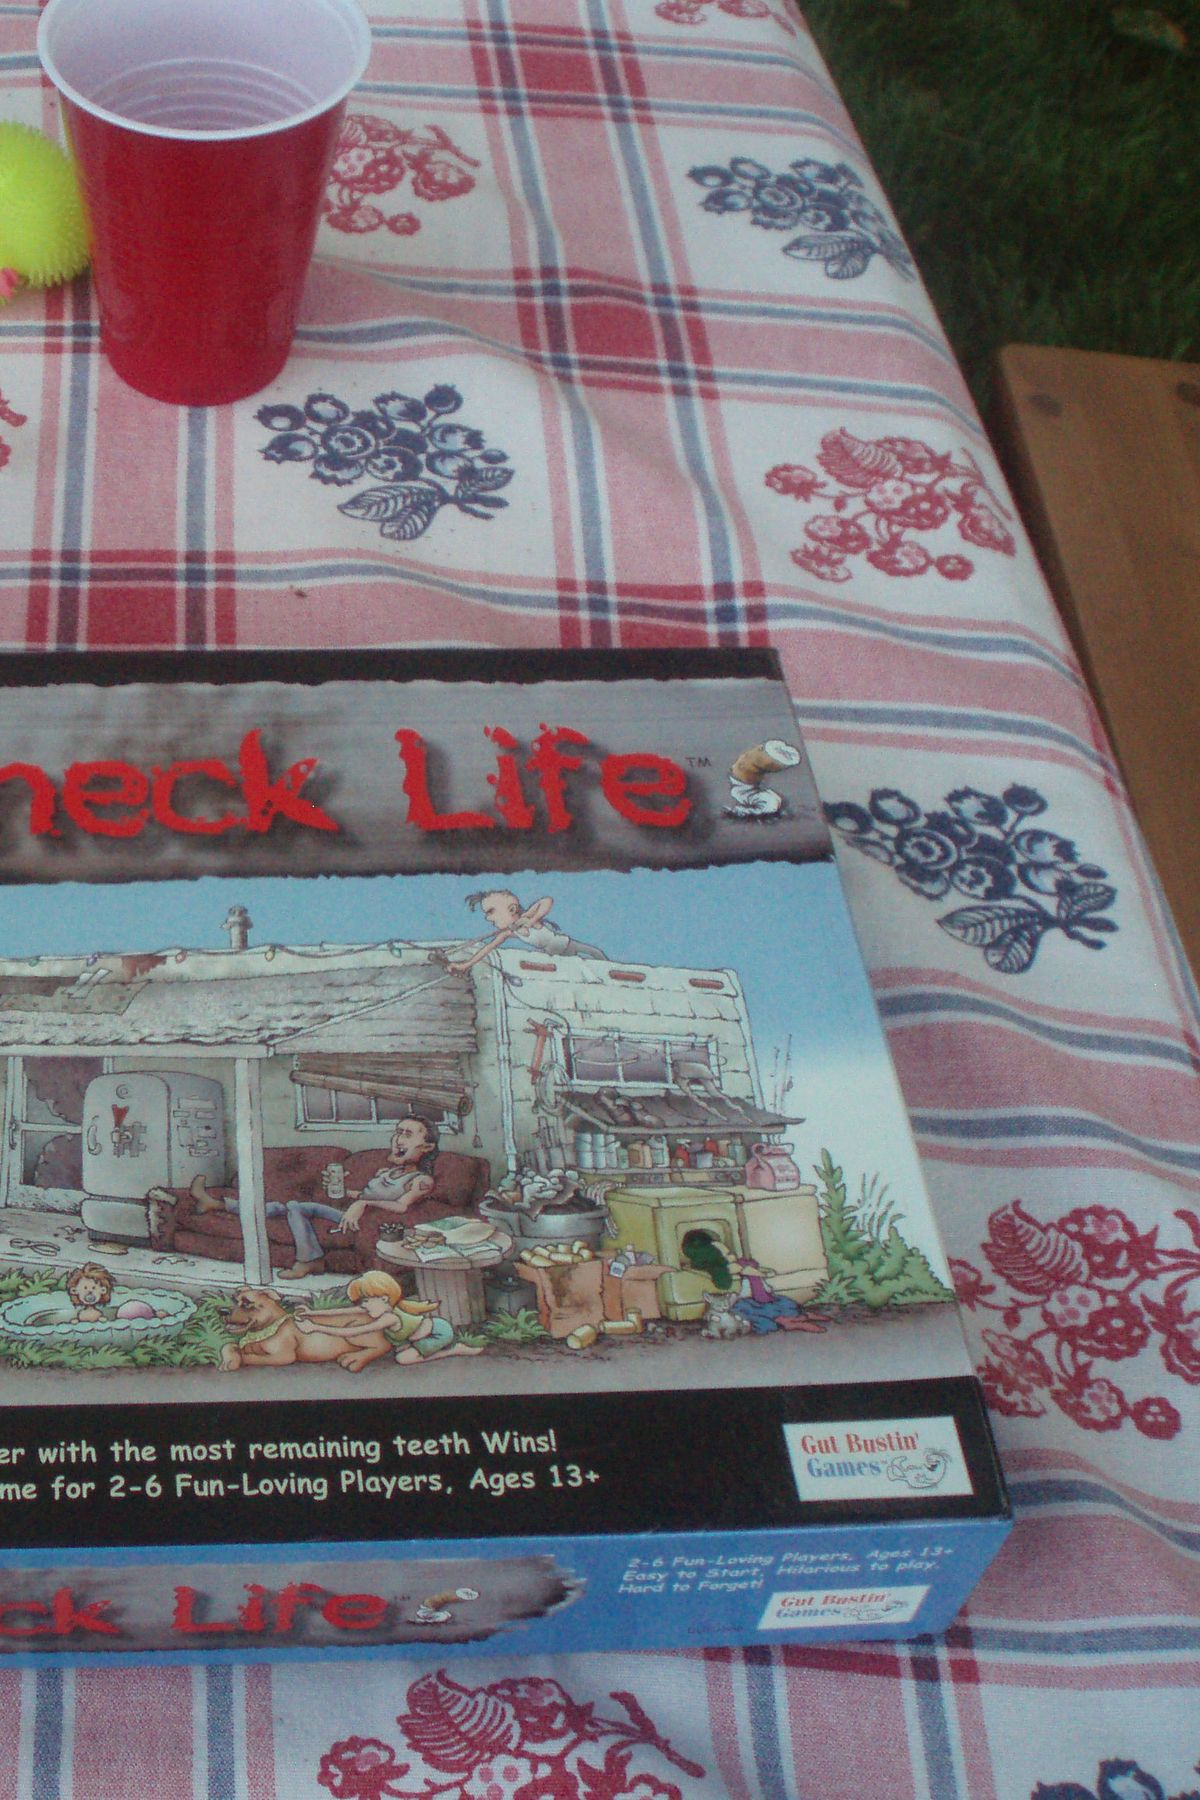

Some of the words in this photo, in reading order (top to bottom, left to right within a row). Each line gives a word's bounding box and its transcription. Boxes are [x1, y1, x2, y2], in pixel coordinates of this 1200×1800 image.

[394, 722, 692, 833] Life
[38, 1439, 97, 1464] with
[110, 1439, 157, 1462] the
[170, 1440, 236, 1462] most
[249, 1436, 381, 1464] remaining
[392, 1432, 471, 1457] teeth
[481, 1429, 558, 1454] Wins!
[801, 1435, 839, 1455] Gut
[845, 1431, 919, 1454] Bustin'
[807, 1458, 881, 1478] Games
[50, 1475, 96, 1500] for
[109, 1474, 162, 1498] 2-6
[175, 1472, 328, 1501] Fun-Loving
[340, 1469, 453, 1499] Players,
[469, 1467, 536, 1496] Ages
[549, 1464, 601, 1488] 13+
[628, 1557, 664, 1569] 2-6
[672, 1554, 775, 1567] Fun-Loving
[866, 1549, 912, 1561] Ages
[920, 1546, 954, 1557] 13+
[622, 1570, 669, 1582] Easy
[677, 1570, 697, 1580] to
[777, 1561, 862, 1575] Hilarious
[870, 1561, 889, 1571] to
[618, 1583, 665, 1594] Hard
[673, 1583, 691, 1592] to
[171, 1582, 388, 1634] Life
[776, 1608, 842, 1619] Games
[780, 1596, 816, 1608] Gut
